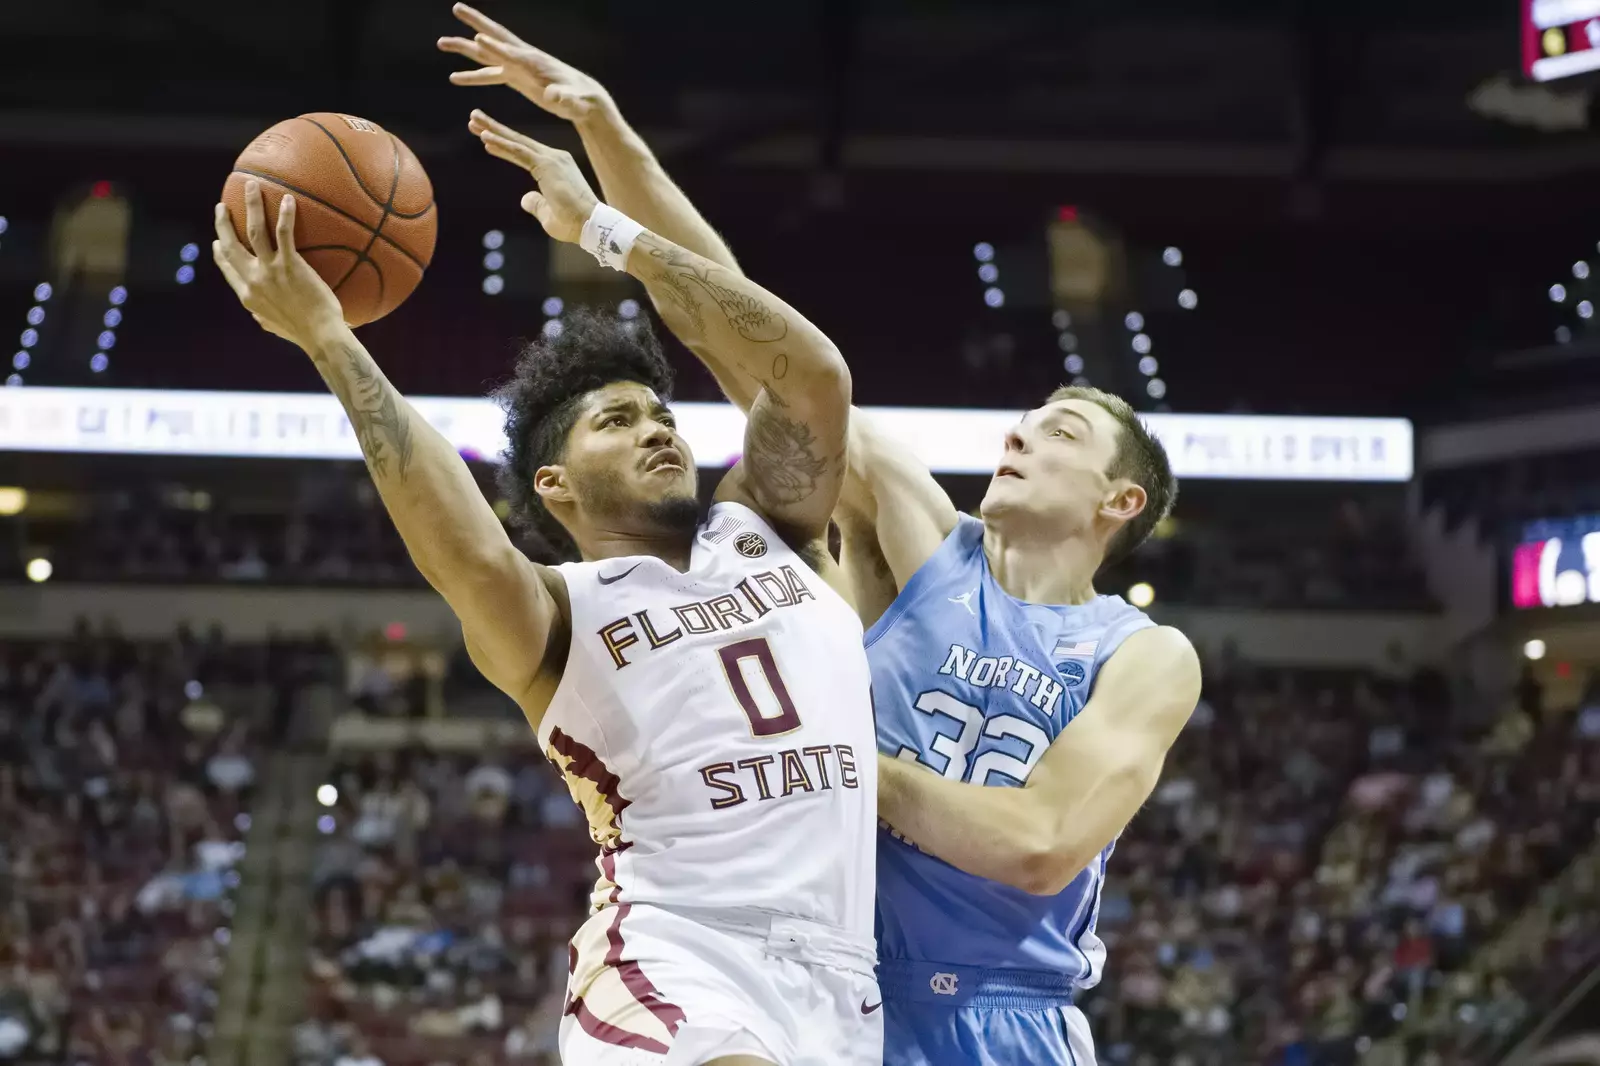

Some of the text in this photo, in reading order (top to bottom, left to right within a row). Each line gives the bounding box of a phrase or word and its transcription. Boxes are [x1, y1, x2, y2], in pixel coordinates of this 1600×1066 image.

[597, 565, 816, 670] FLORIDA
[714, 636, 803, 739] 0
[938, 644, 1064, 719] NORTH
[698, 744, 859, 810] STATE
[897, 688, 1051, 788] 32
